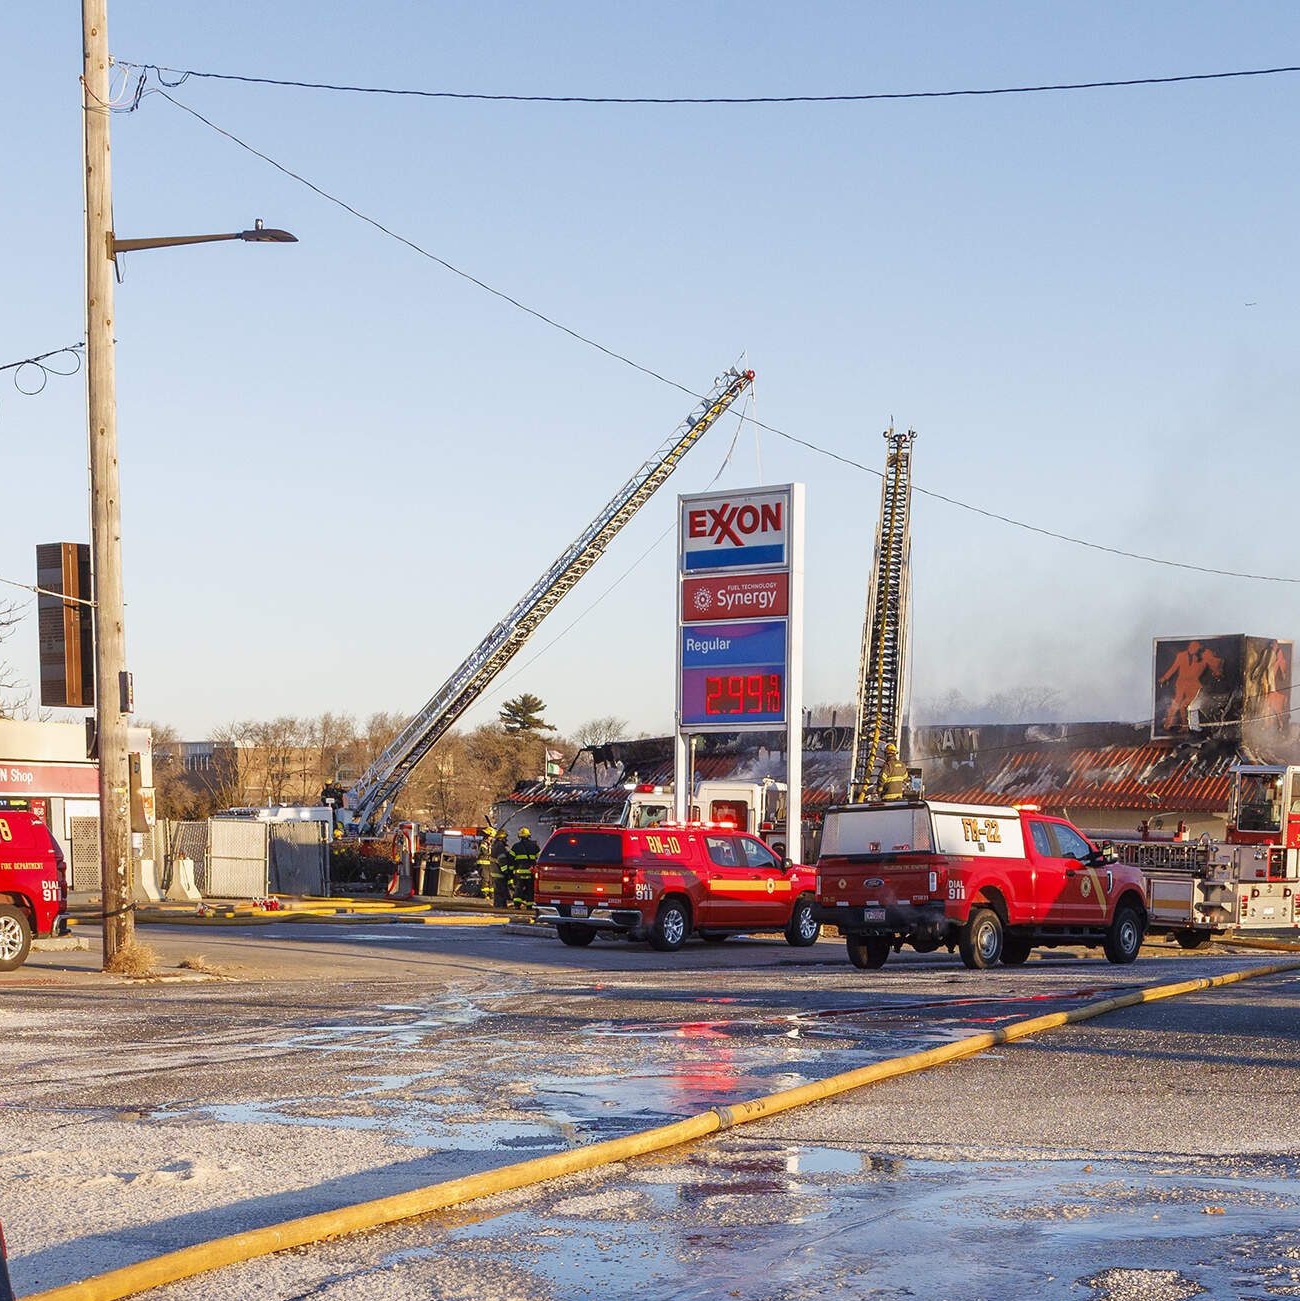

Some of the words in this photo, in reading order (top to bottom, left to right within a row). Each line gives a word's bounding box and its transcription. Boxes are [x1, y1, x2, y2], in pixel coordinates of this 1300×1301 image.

[688, 502, 782, 546] EXXON
[741, 582, 777, 590] TECHNOLOGY
[716, 589, 777, 611] Synergy
[686, 637, 731, 654] Regular
[10, 767, 34, 785] Shop
[961, 817, 1002, 843] FM-22
[646, 835, 682, 855] BN-10
[0, 862, 13, 870] FIRE
[13, 862, 44, 870] DEPARTMENT
[635, 883, 652, 891] DIAL
[948, 880, 965, 888] DIAL
[635, 890, 653, 901] 911
[948, 888, 966, 900] 911
